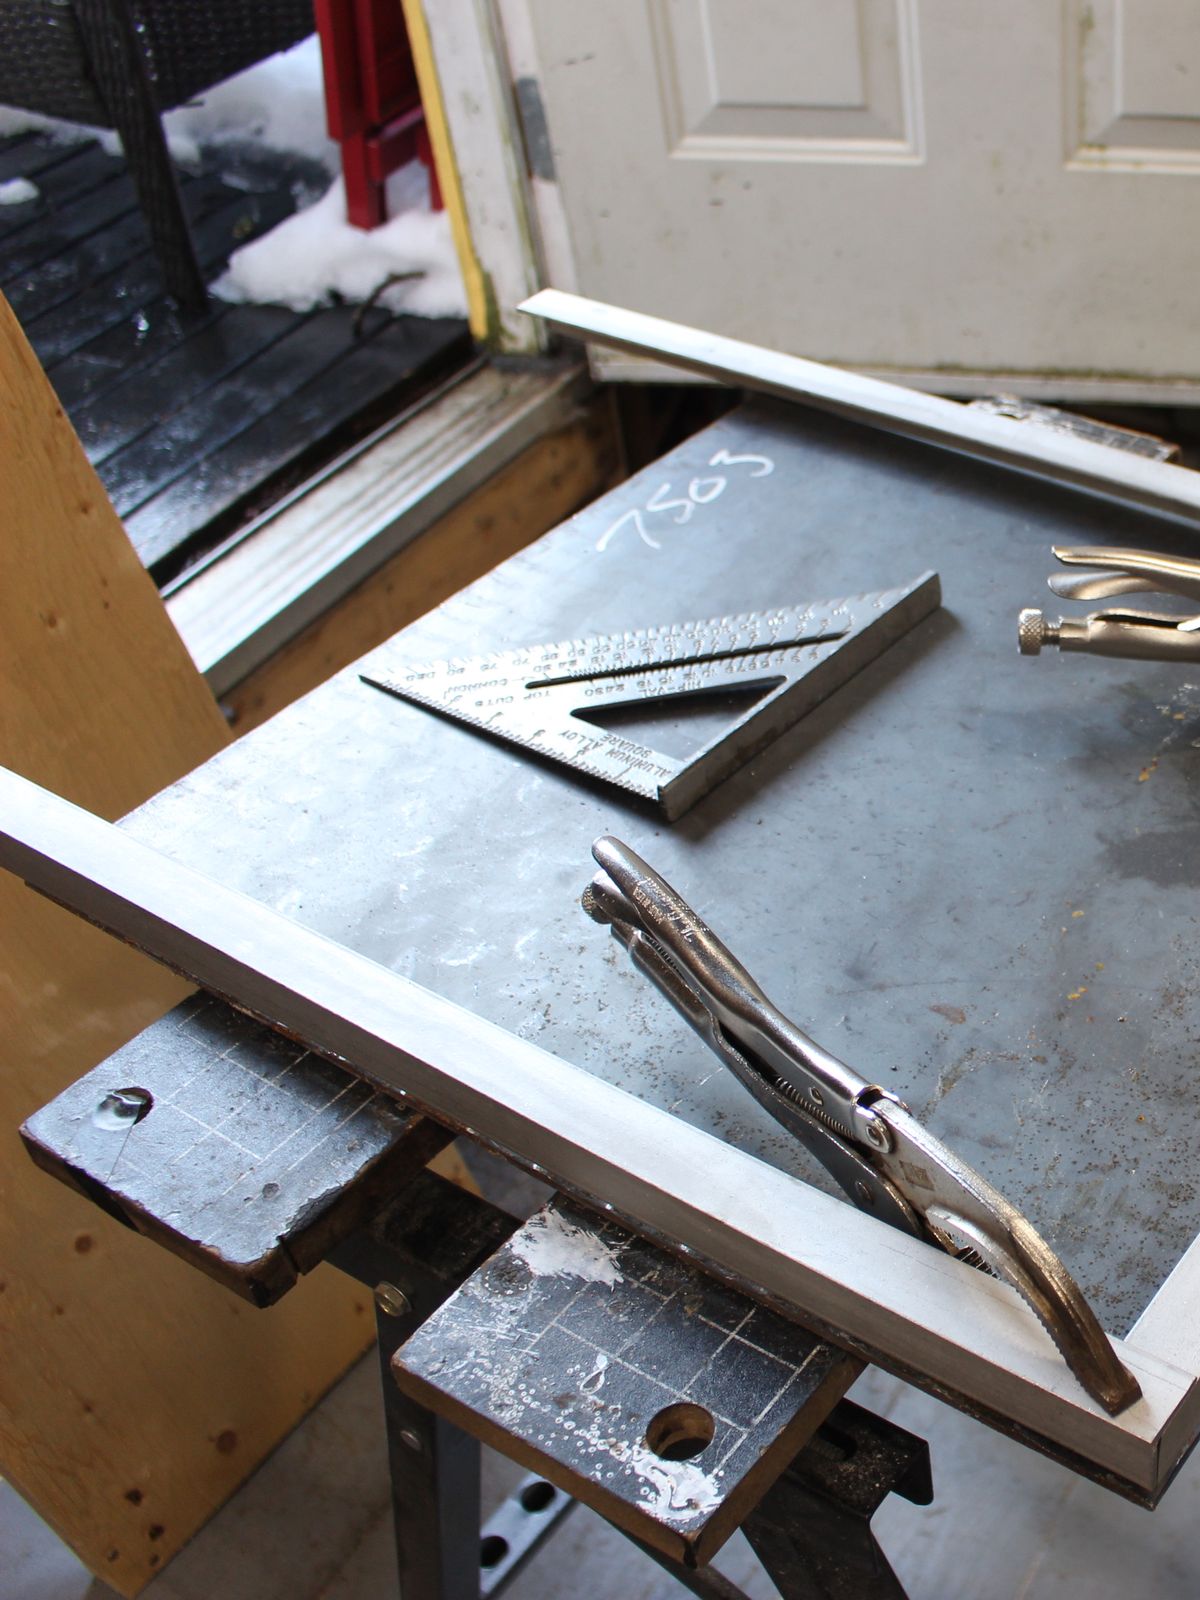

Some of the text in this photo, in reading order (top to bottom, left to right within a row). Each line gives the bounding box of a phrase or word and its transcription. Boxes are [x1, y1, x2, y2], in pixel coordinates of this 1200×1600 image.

[558, 729, 672, 778] ALUMINUM ALLOY
[600, 732, 653, 759] SQUARE
